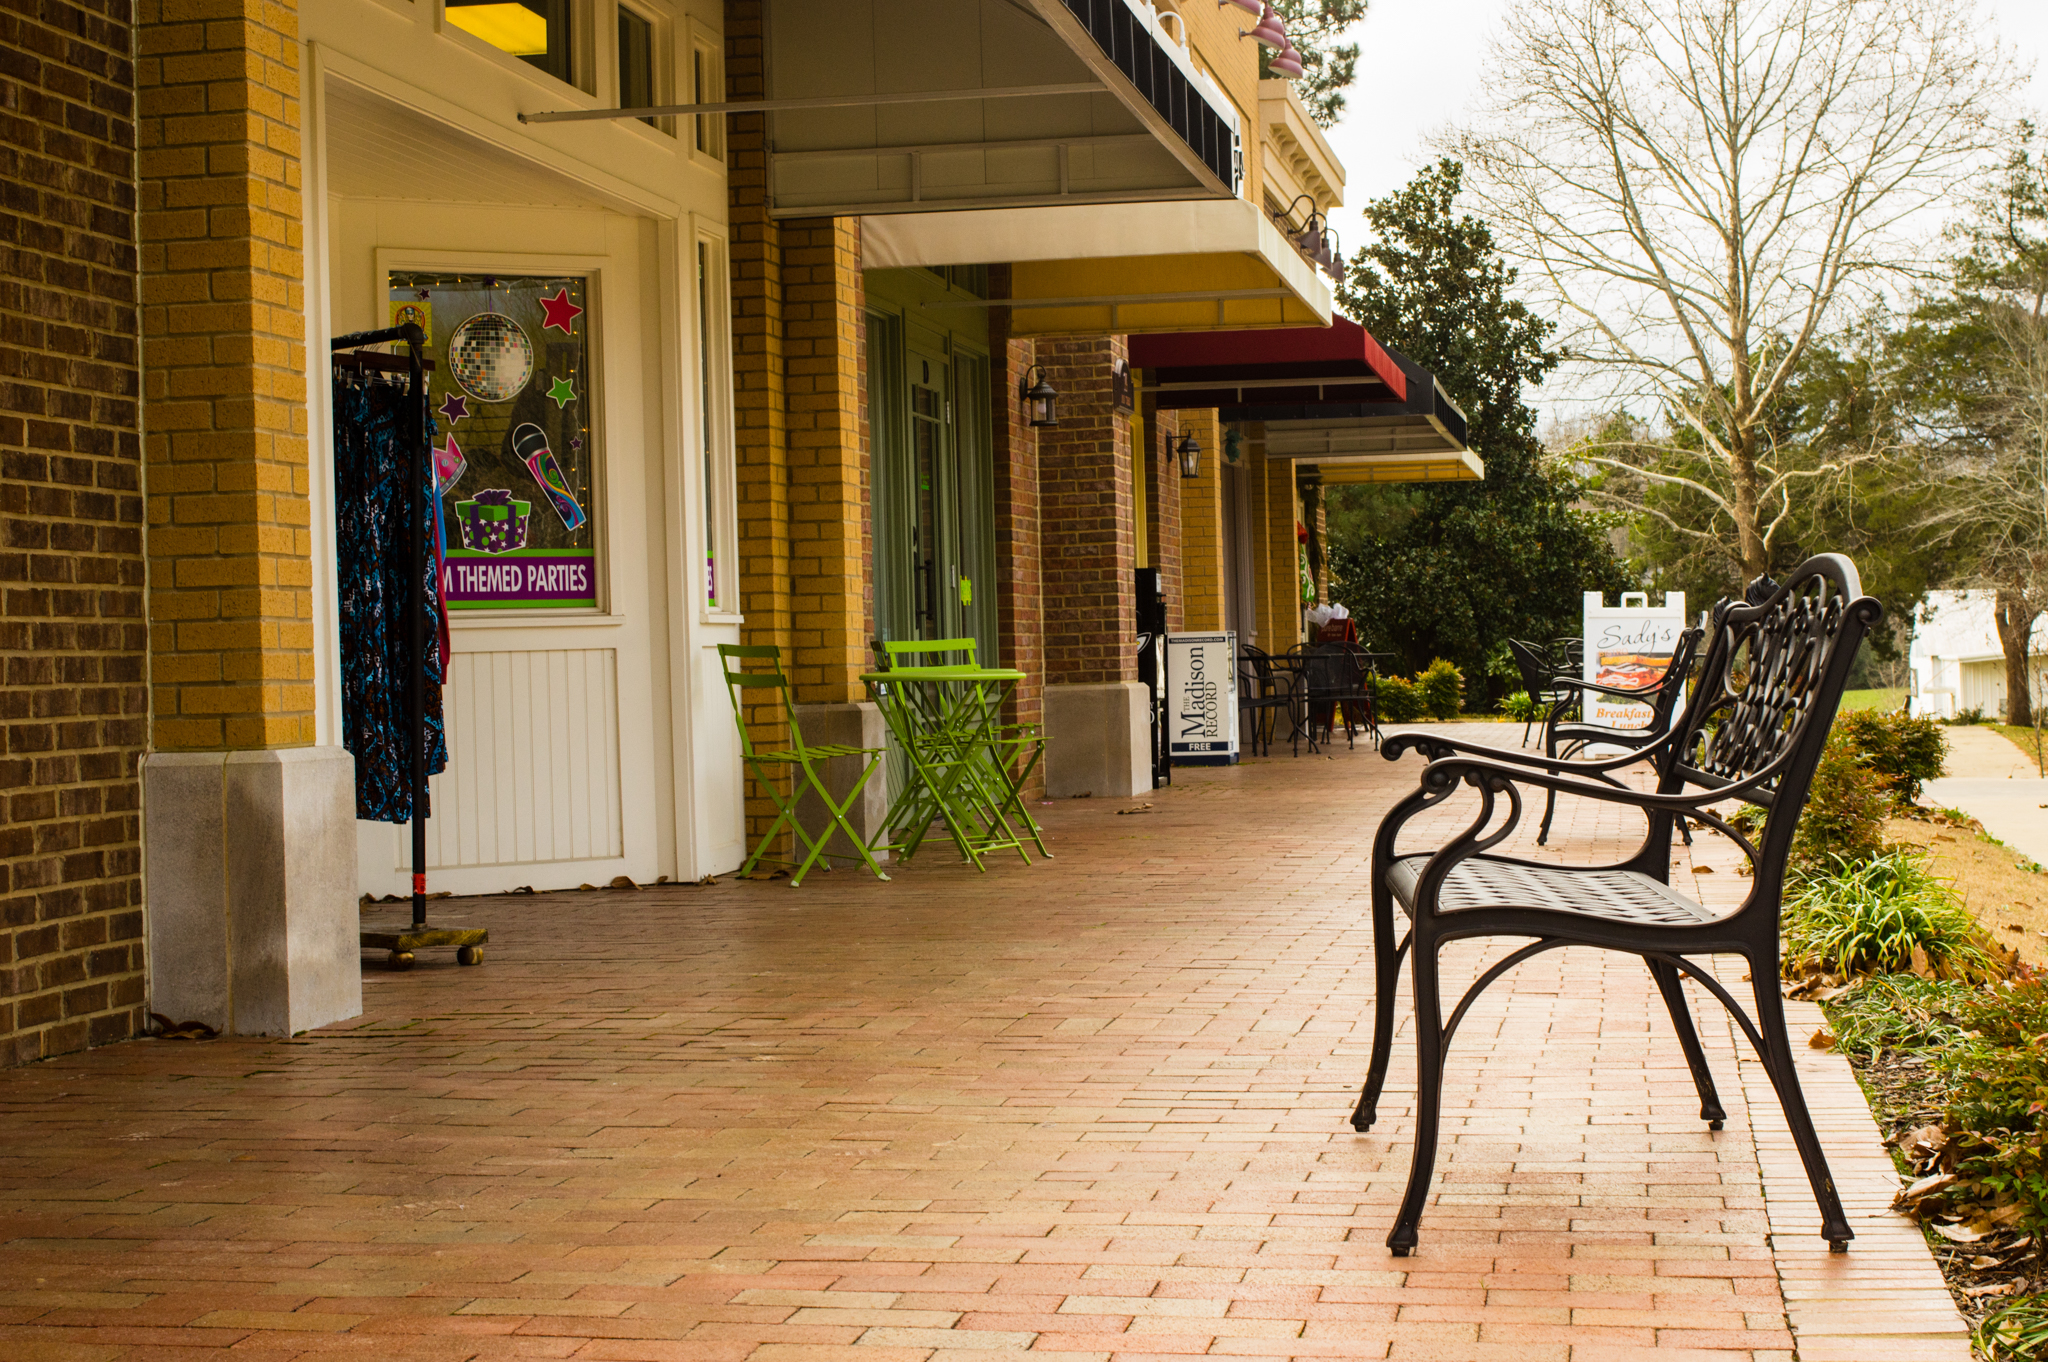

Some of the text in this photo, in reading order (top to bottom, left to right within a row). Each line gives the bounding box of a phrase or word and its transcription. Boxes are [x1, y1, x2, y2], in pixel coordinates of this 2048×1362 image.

[457, 565, 522, 592] THEMED
[527, 564, 587, 592] PARTIES
[1597, 619, 1674, 659] Sady's
[1180, 646, 1206, 738] Madison
[1205, 681, 1218, 737] RECORD
[1188, 742, 1211, 751] FREE
